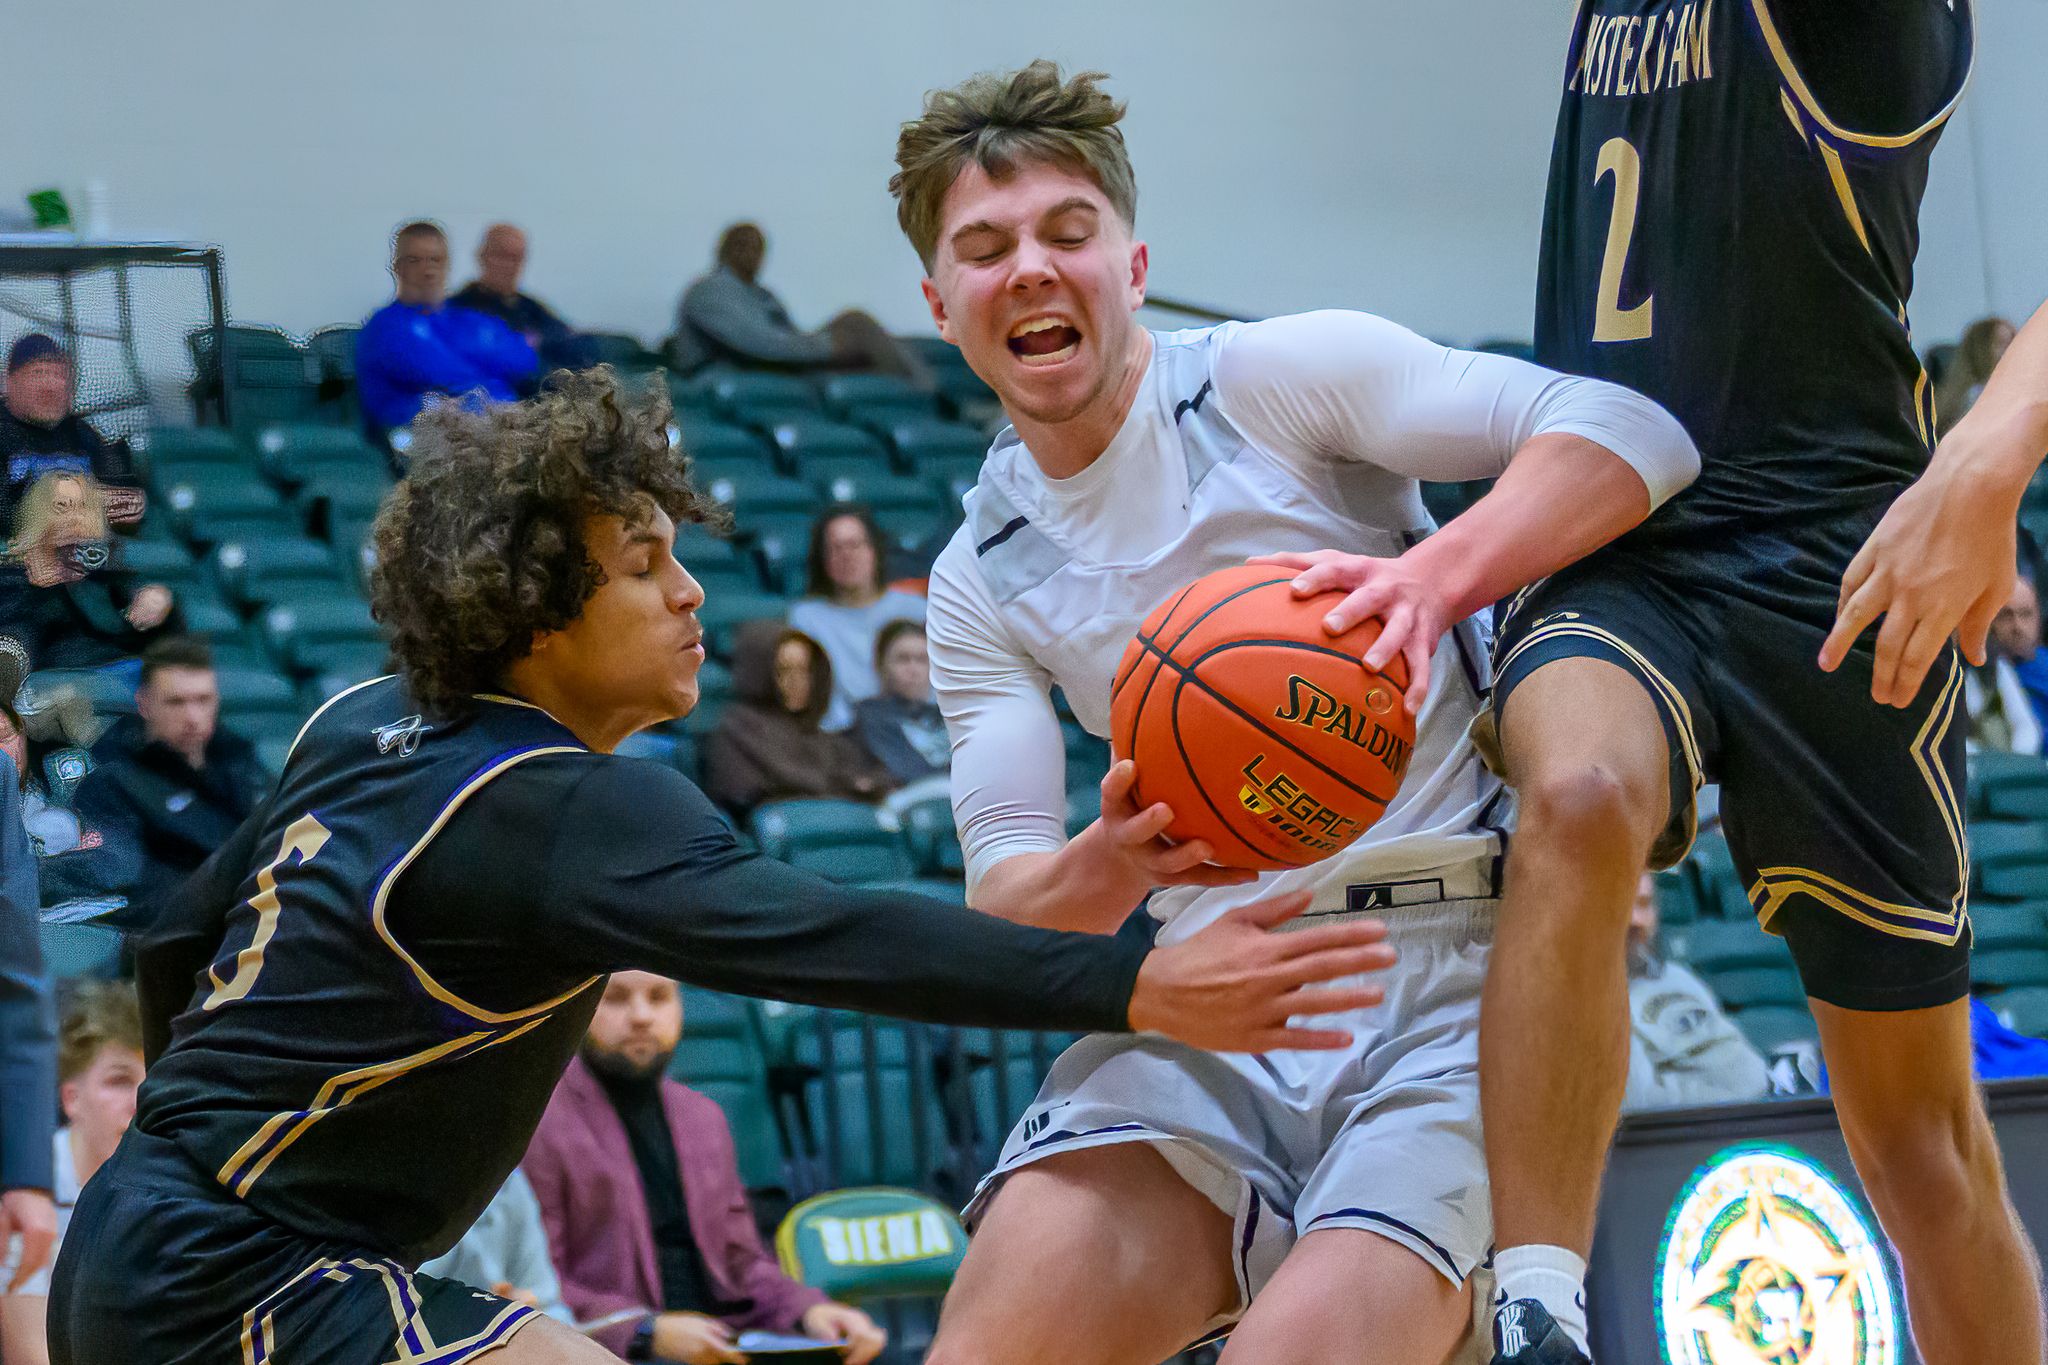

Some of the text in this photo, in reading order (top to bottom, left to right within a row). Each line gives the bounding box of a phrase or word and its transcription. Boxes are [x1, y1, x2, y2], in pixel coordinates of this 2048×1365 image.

[1569, 0, 1714, 96] MSTERDAM
[1592, 136, 1653, 342] 2
[1274, 674, 1415, 778] SPALDIN
